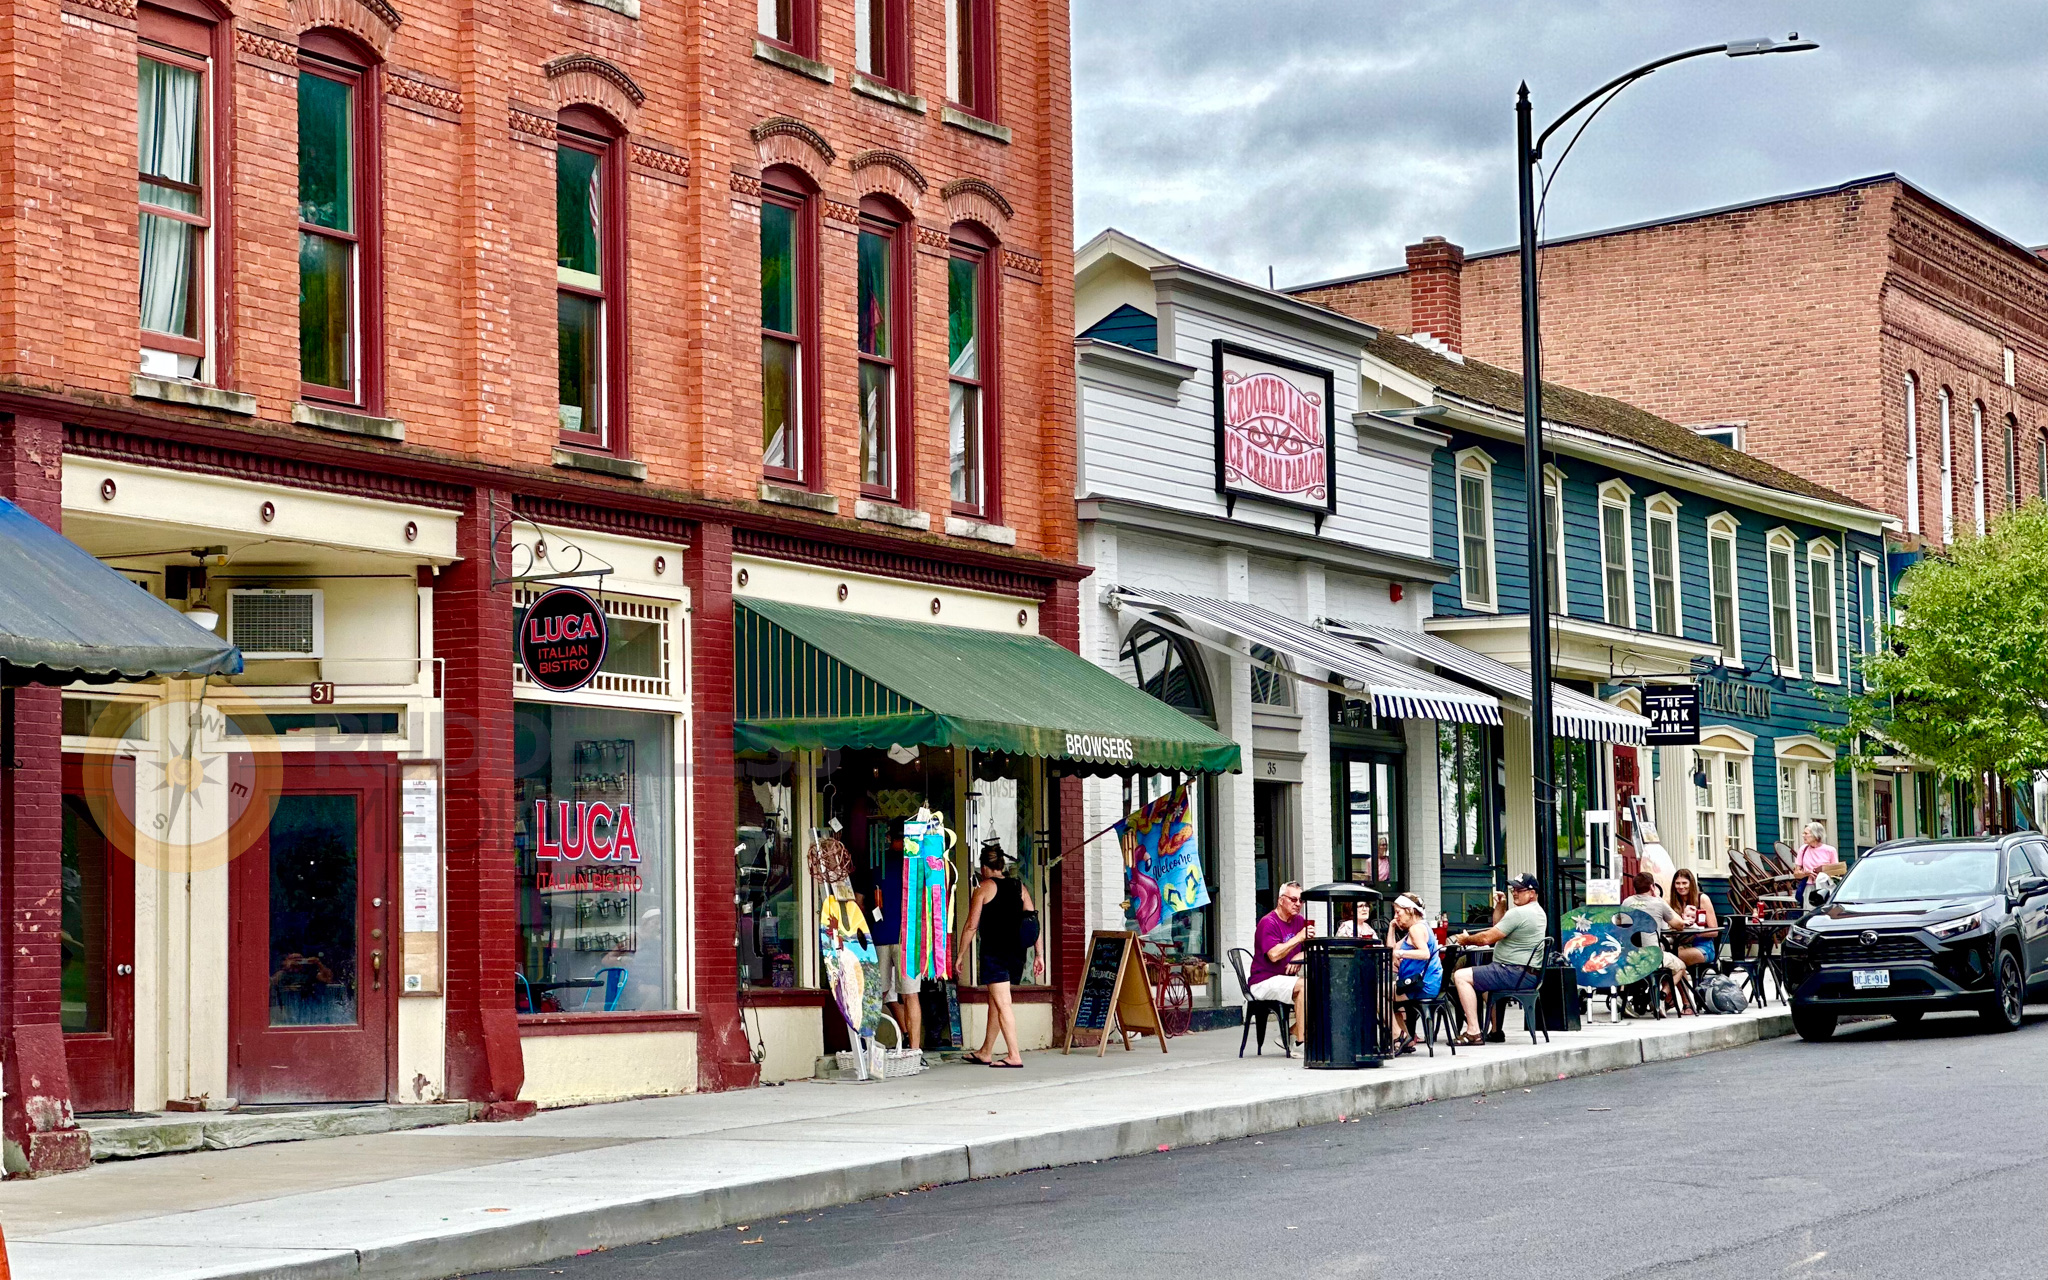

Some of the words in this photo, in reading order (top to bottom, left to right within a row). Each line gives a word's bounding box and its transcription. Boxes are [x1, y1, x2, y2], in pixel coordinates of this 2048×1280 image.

[1228, 376, 1286, 425] CROOKED
[1288, 385, 1319, 442] LAKE
[1224, 431, 1244, 470] ICE
[1246, 446, 1283, 490] CREAM
[1285, 451, 1325, 490] PARLOR
[530, 613, 599, 644] LUCA
[538, 644, 588, 660] ITALIAN
[539, 659, 590, 674] BISTRO
[312, 683, 332, 702] 31
[1660, 697, 1681, 708] THE
[1745, 684, 1772, 719] INN
[1651, 708, 1690, 722] PARK
[1660, 722, 1681, 733] INN
[1065, 733, 1134, 760] BROWSERS
[1267, 761, 1277, 775] 35
[535, 800, 641, 862] LUCA
[1152, 853, 1192, 881] Welcome
[536, 872, 588, 891] ITALIAN
[592, 873, 643, 893] BISTRO
